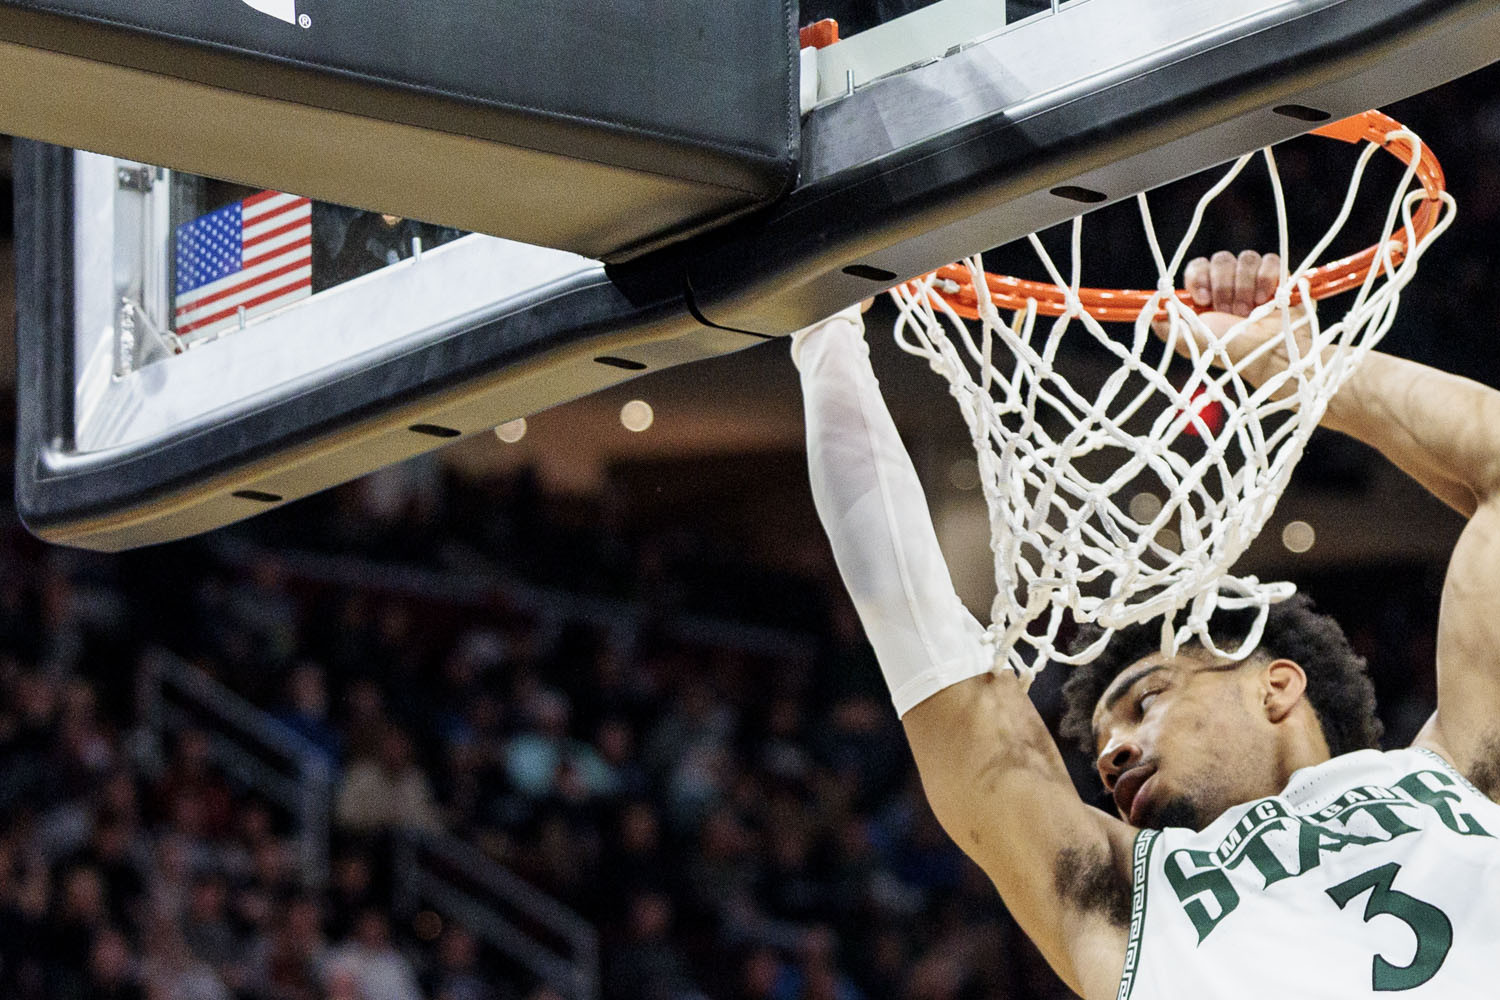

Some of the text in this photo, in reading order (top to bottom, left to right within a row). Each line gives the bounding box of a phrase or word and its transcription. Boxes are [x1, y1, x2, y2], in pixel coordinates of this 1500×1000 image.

[1164, 770, 1499, 949] STATE
[1218, 785, 1397, 859] MICIGAN
[1325, 862, 1453, 992] 3
